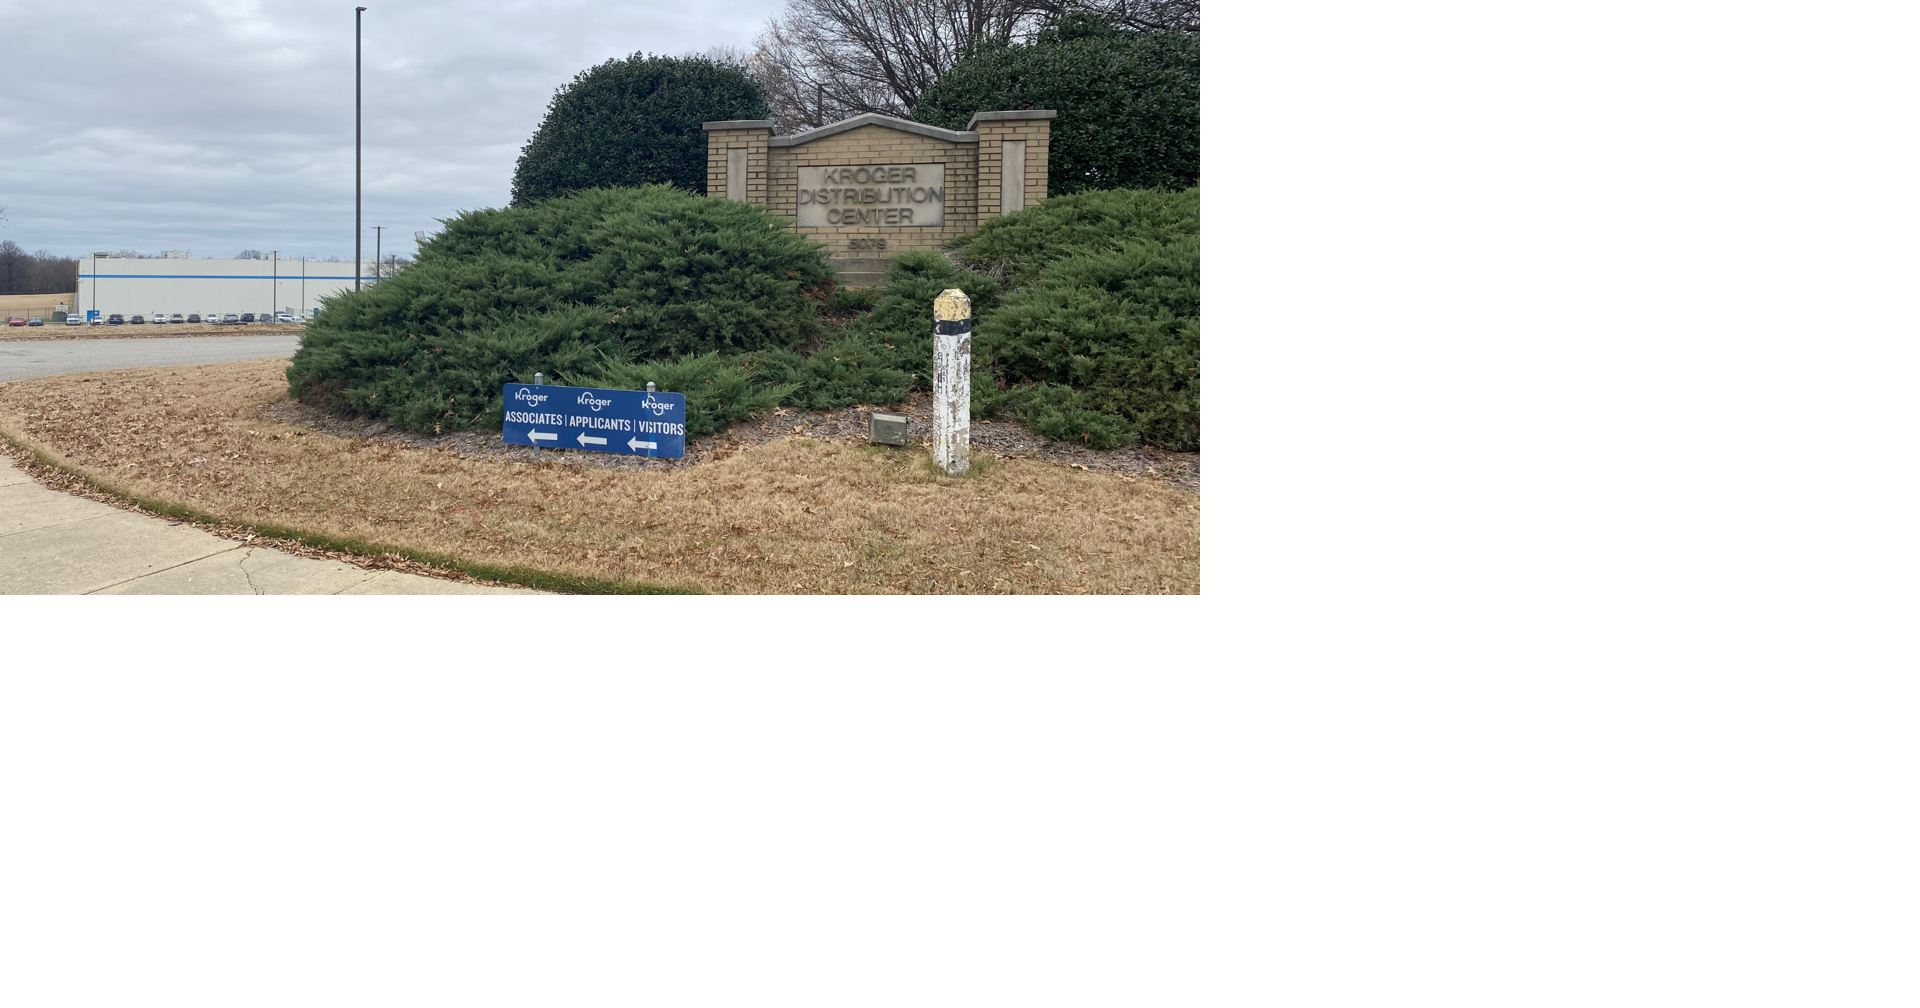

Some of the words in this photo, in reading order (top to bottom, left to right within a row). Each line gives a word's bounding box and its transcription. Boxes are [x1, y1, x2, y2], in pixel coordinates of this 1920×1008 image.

[823, 166, 917, 184] KROGER
[798, 186, 944, 205] DISTRIBUTION
[826, 207, 914, 224] CENTER
[514, 387, 548, 408] Kroger
[577, 391, 612, 412] Kroger
[641, 395, 675, 416] Kroger
[505, 411, 563, 426] ASSOCIATES
[569, 417, 631, 432] APPLICANTS
[638, 421, 684, 436] VISITORS
